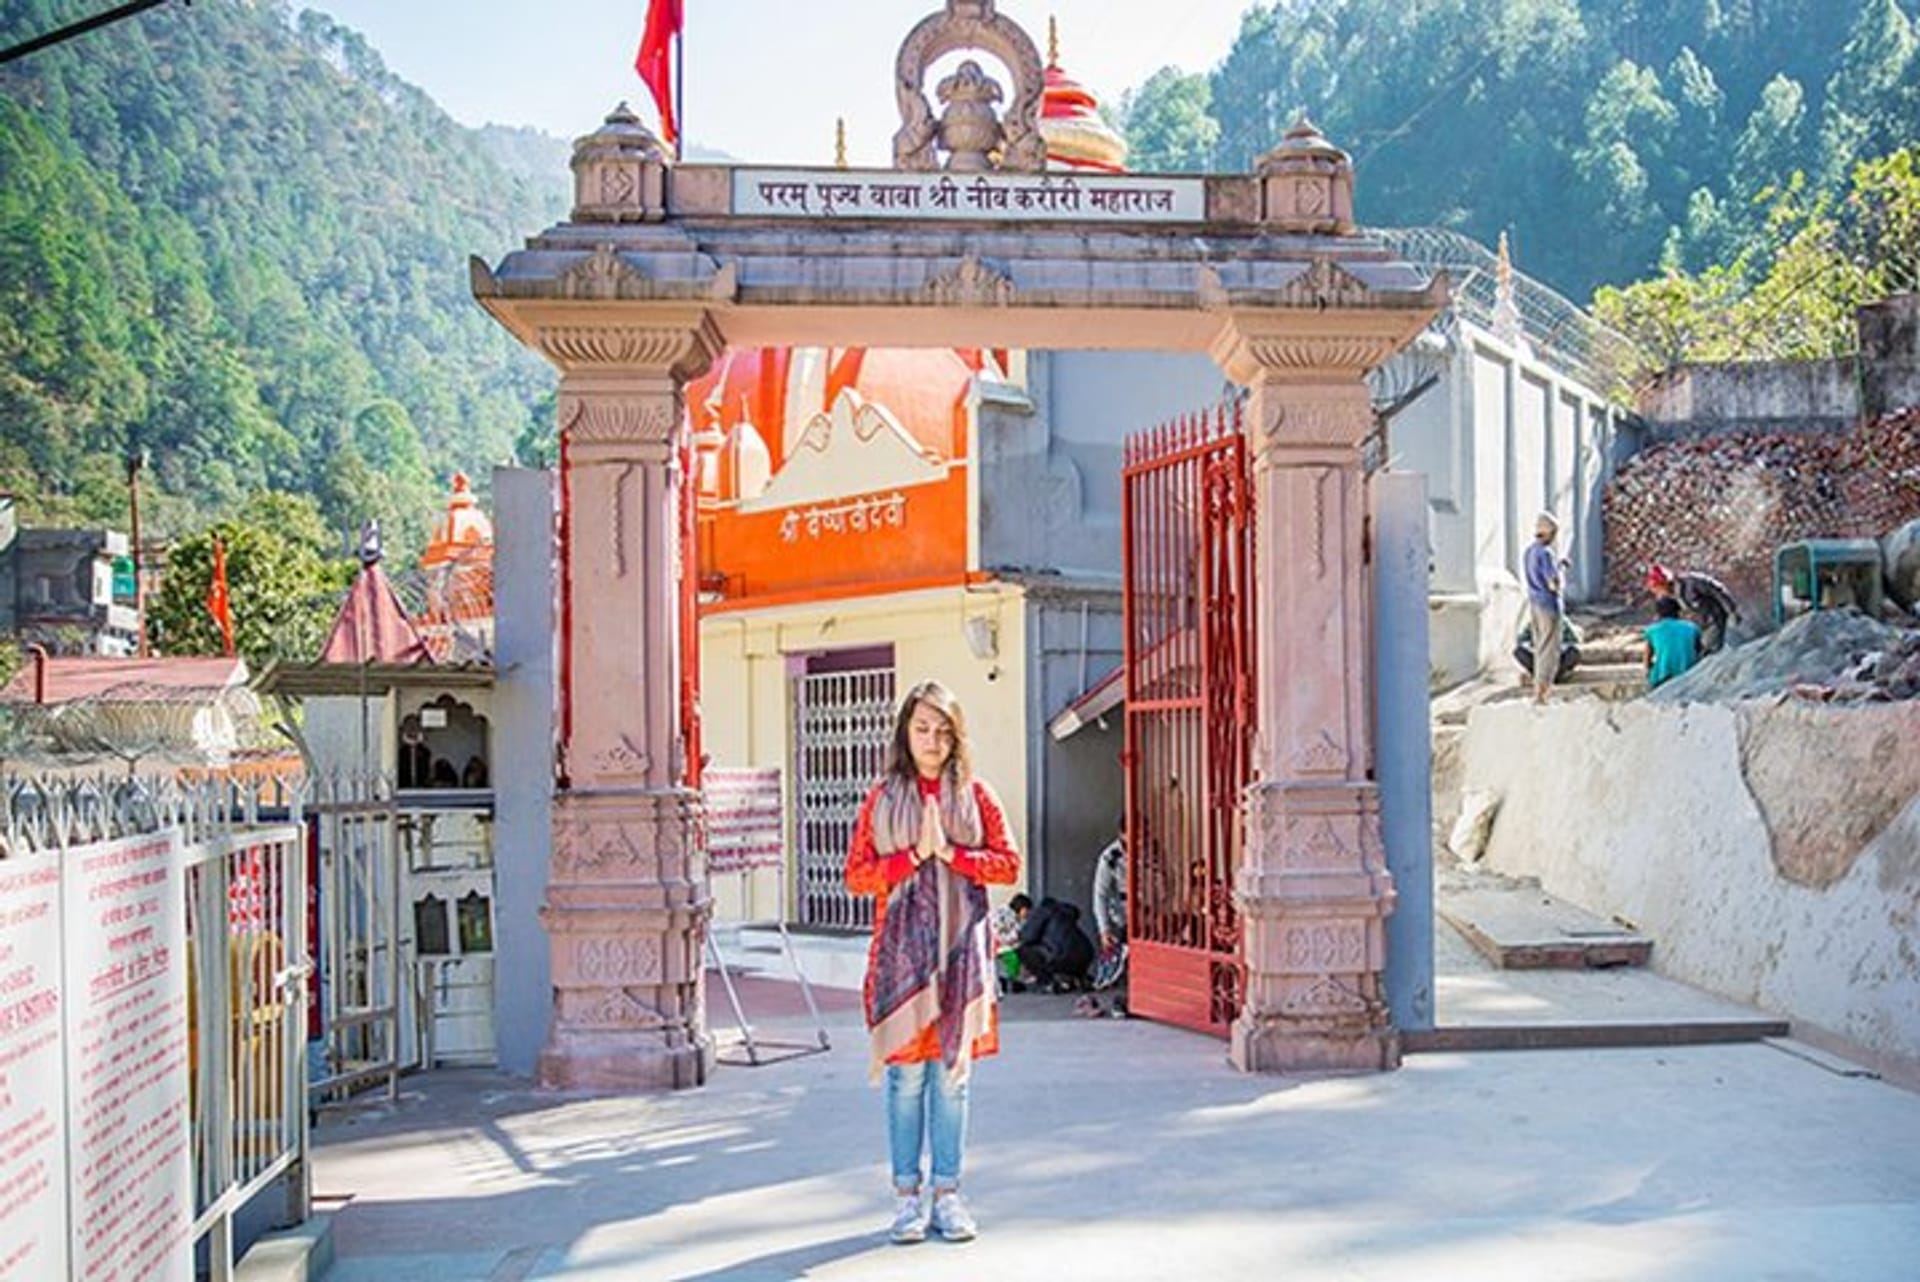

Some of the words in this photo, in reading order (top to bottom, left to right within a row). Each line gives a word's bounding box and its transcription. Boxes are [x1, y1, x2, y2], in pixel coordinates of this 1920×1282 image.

[816, 184, 862, 217] पूज्य
[929, 176, 959, 208] श्री
[1089, 188, 1174, 213] महाराज
